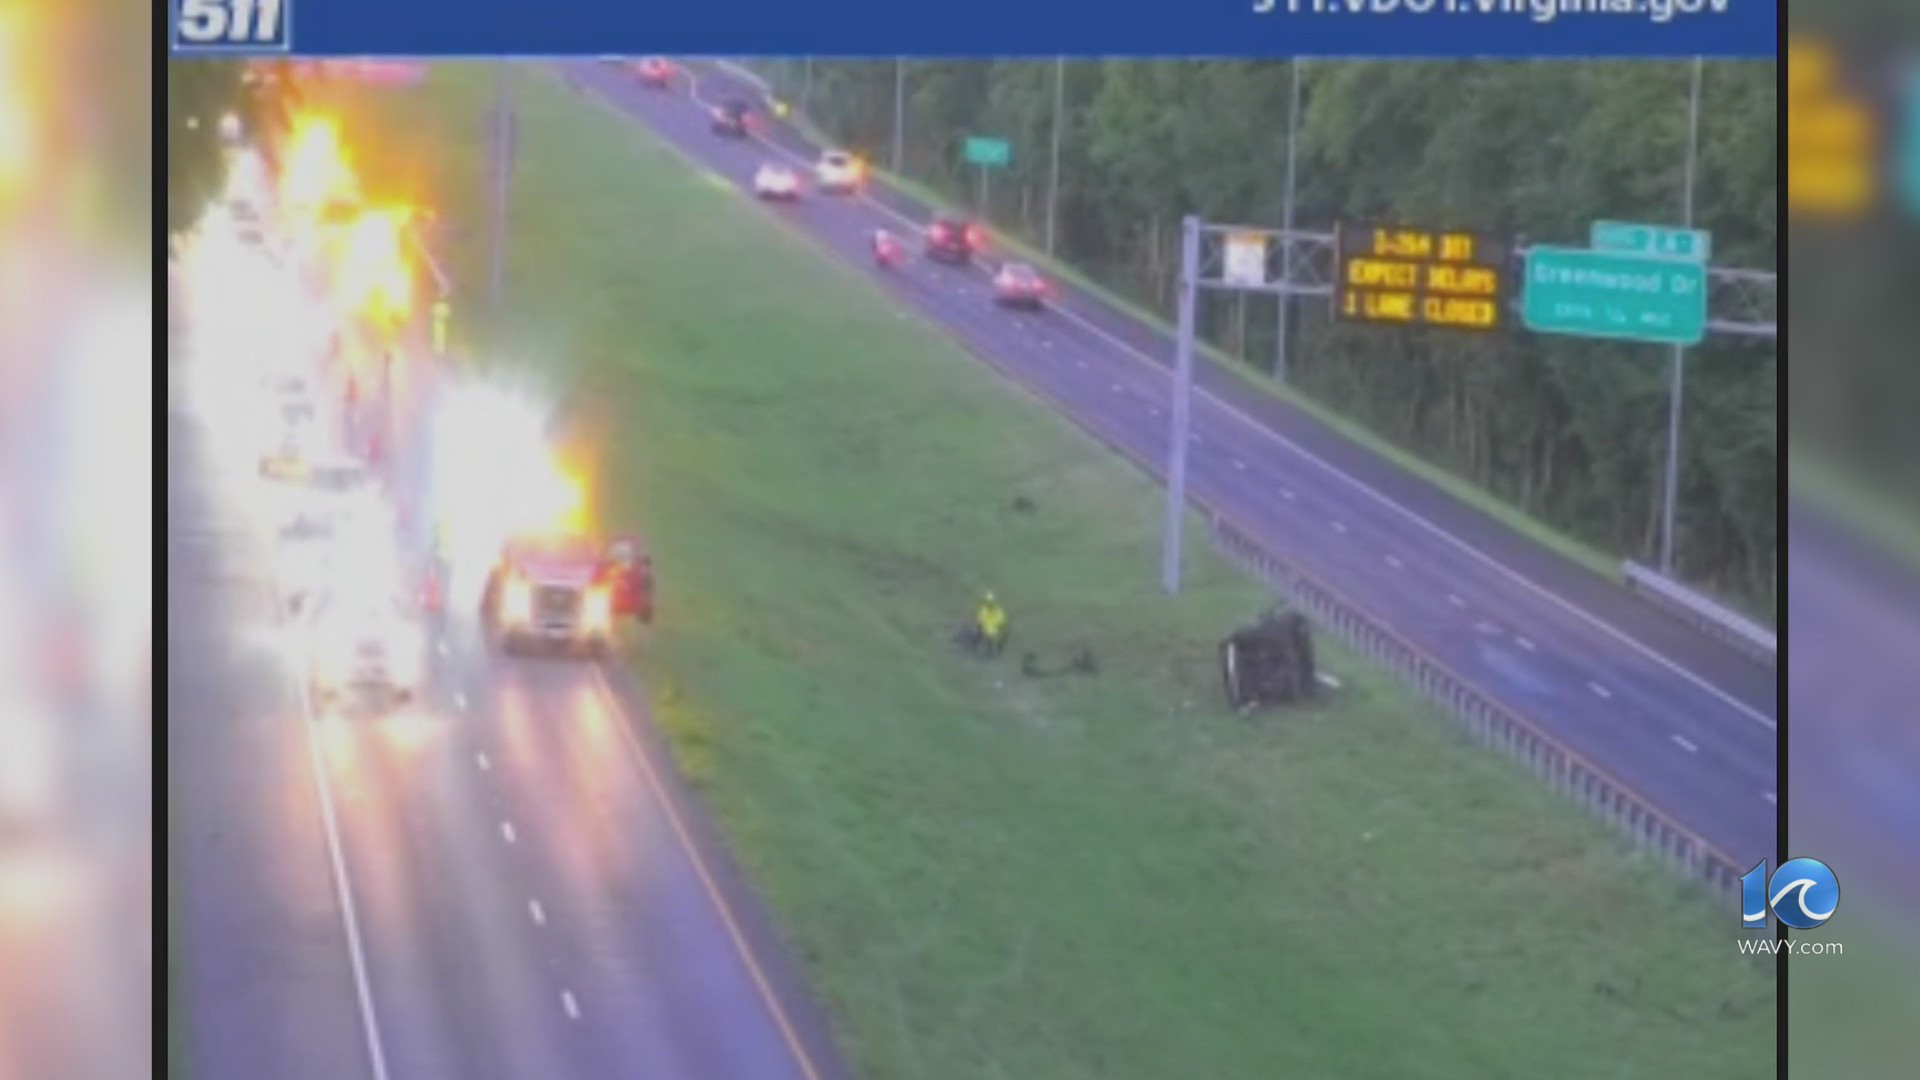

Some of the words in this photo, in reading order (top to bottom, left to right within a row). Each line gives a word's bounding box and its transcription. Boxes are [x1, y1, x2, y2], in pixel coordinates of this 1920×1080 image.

[1349, 259, 1416, 287] EXPECT
[1428, 265, 1496, 294] DELAYS
[1534, 262, 1662, 294] Greenwood
[1671, 273, 1698, 294] Dr
[1363, 292, 1414, 319] LANE
[1424, 296, 1495, 325] CLOSED
